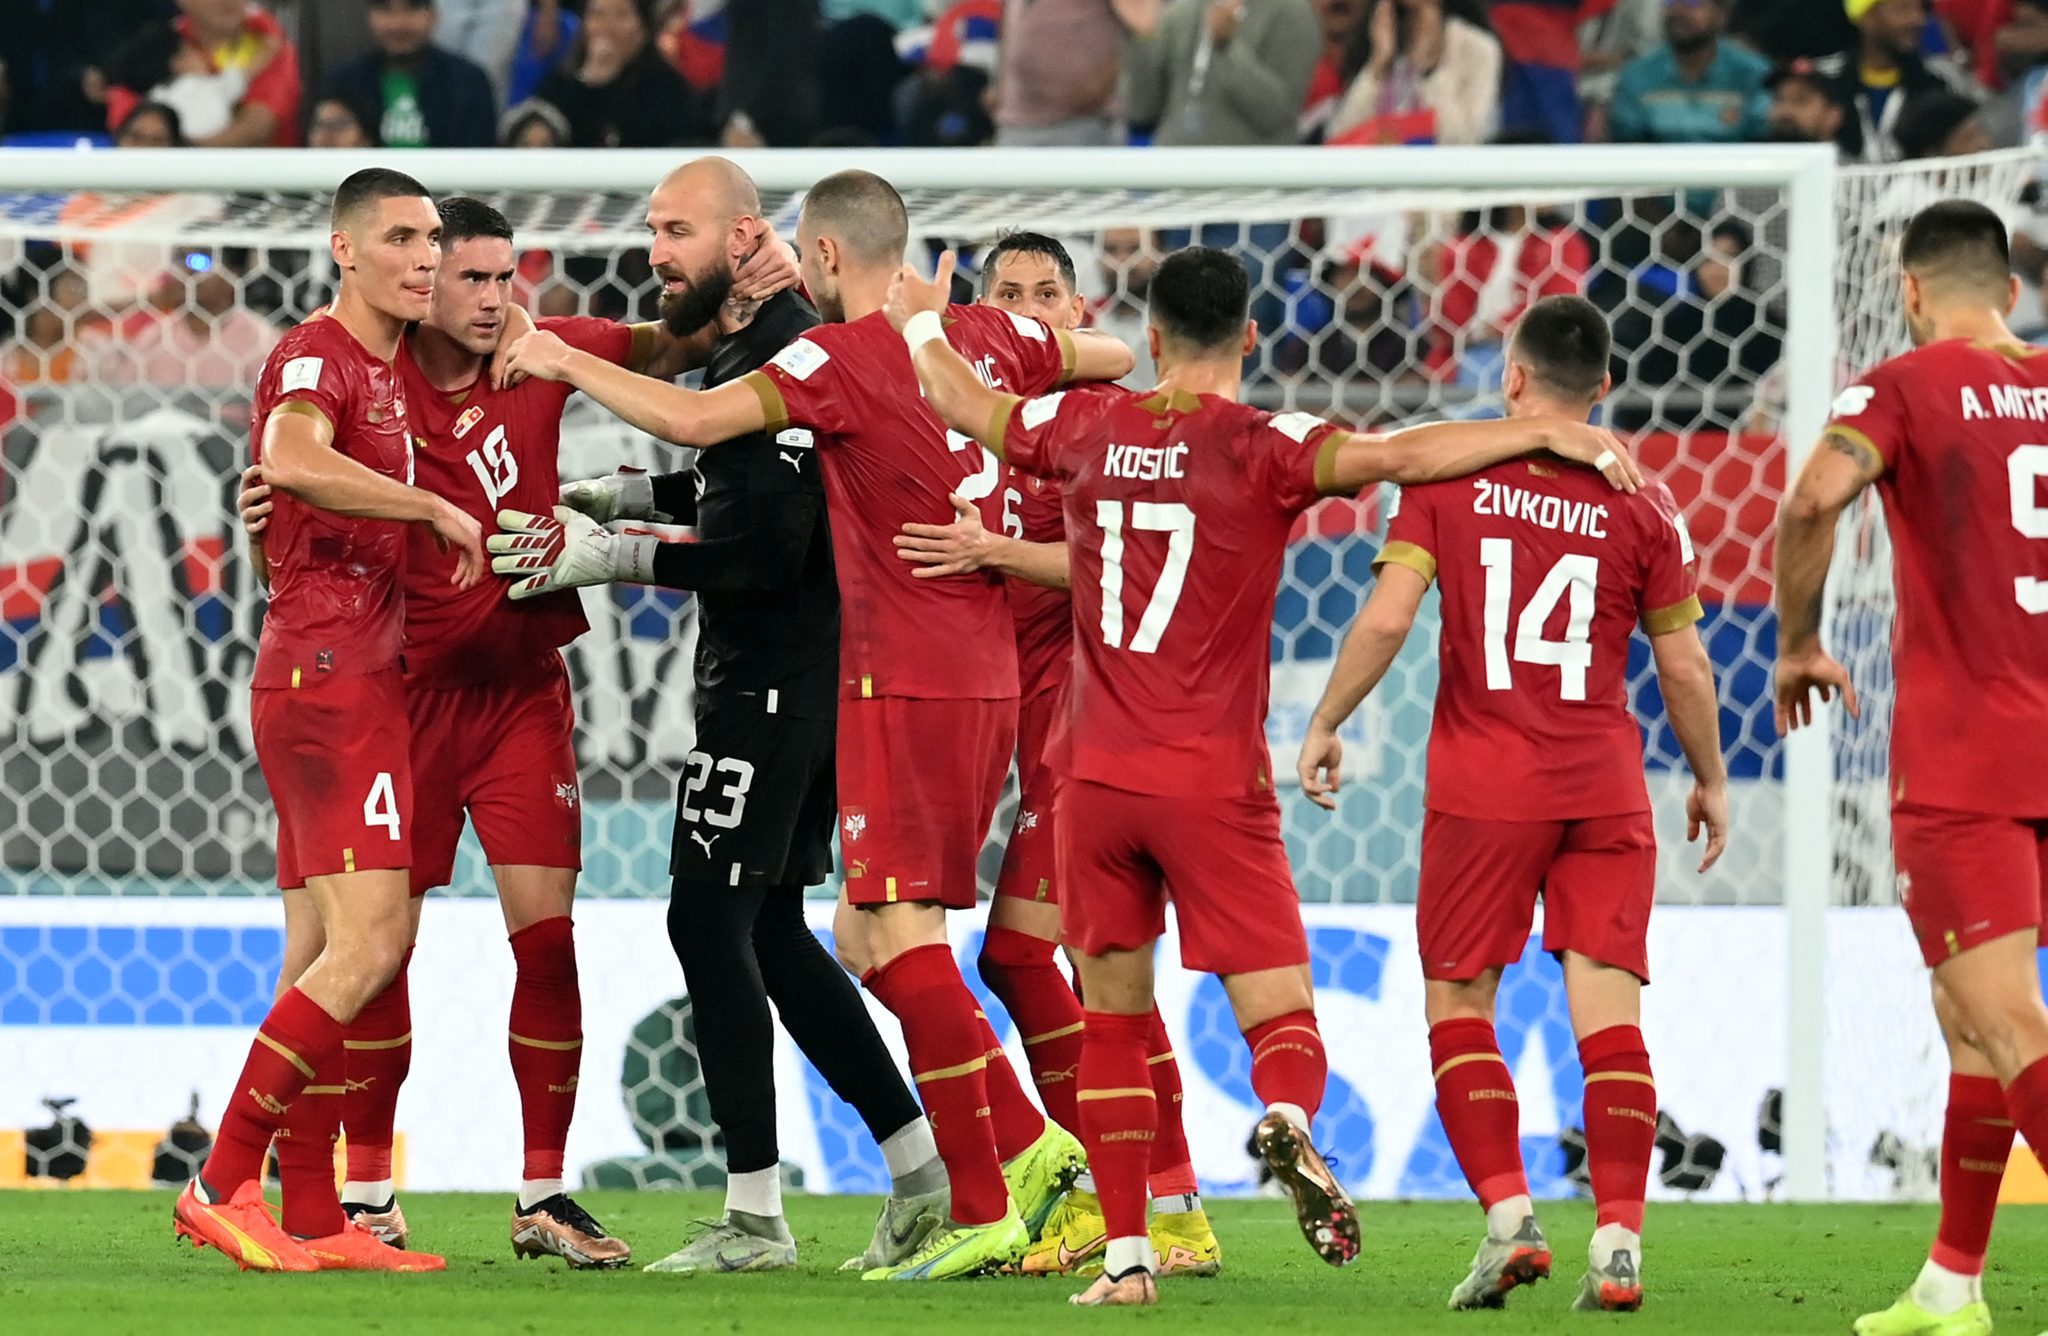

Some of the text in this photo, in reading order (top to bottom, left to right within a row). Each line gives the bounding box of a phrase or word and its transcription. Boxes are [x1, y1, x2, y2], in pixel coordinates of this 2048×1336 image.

[1960, 385, 1992, 421] A.
[465, 424, 518, 512] 18
[1103, 440, 1190, 481] KOSTIĆ
[1472, 477, 1610, 539] ŽIVKOVIĆ
[1095, 499, 1197, 654] 17
[1479, 537, 1599, 701] 14
[363, 771, 401, 841] 4
[681, 750, 755, 830] 23
